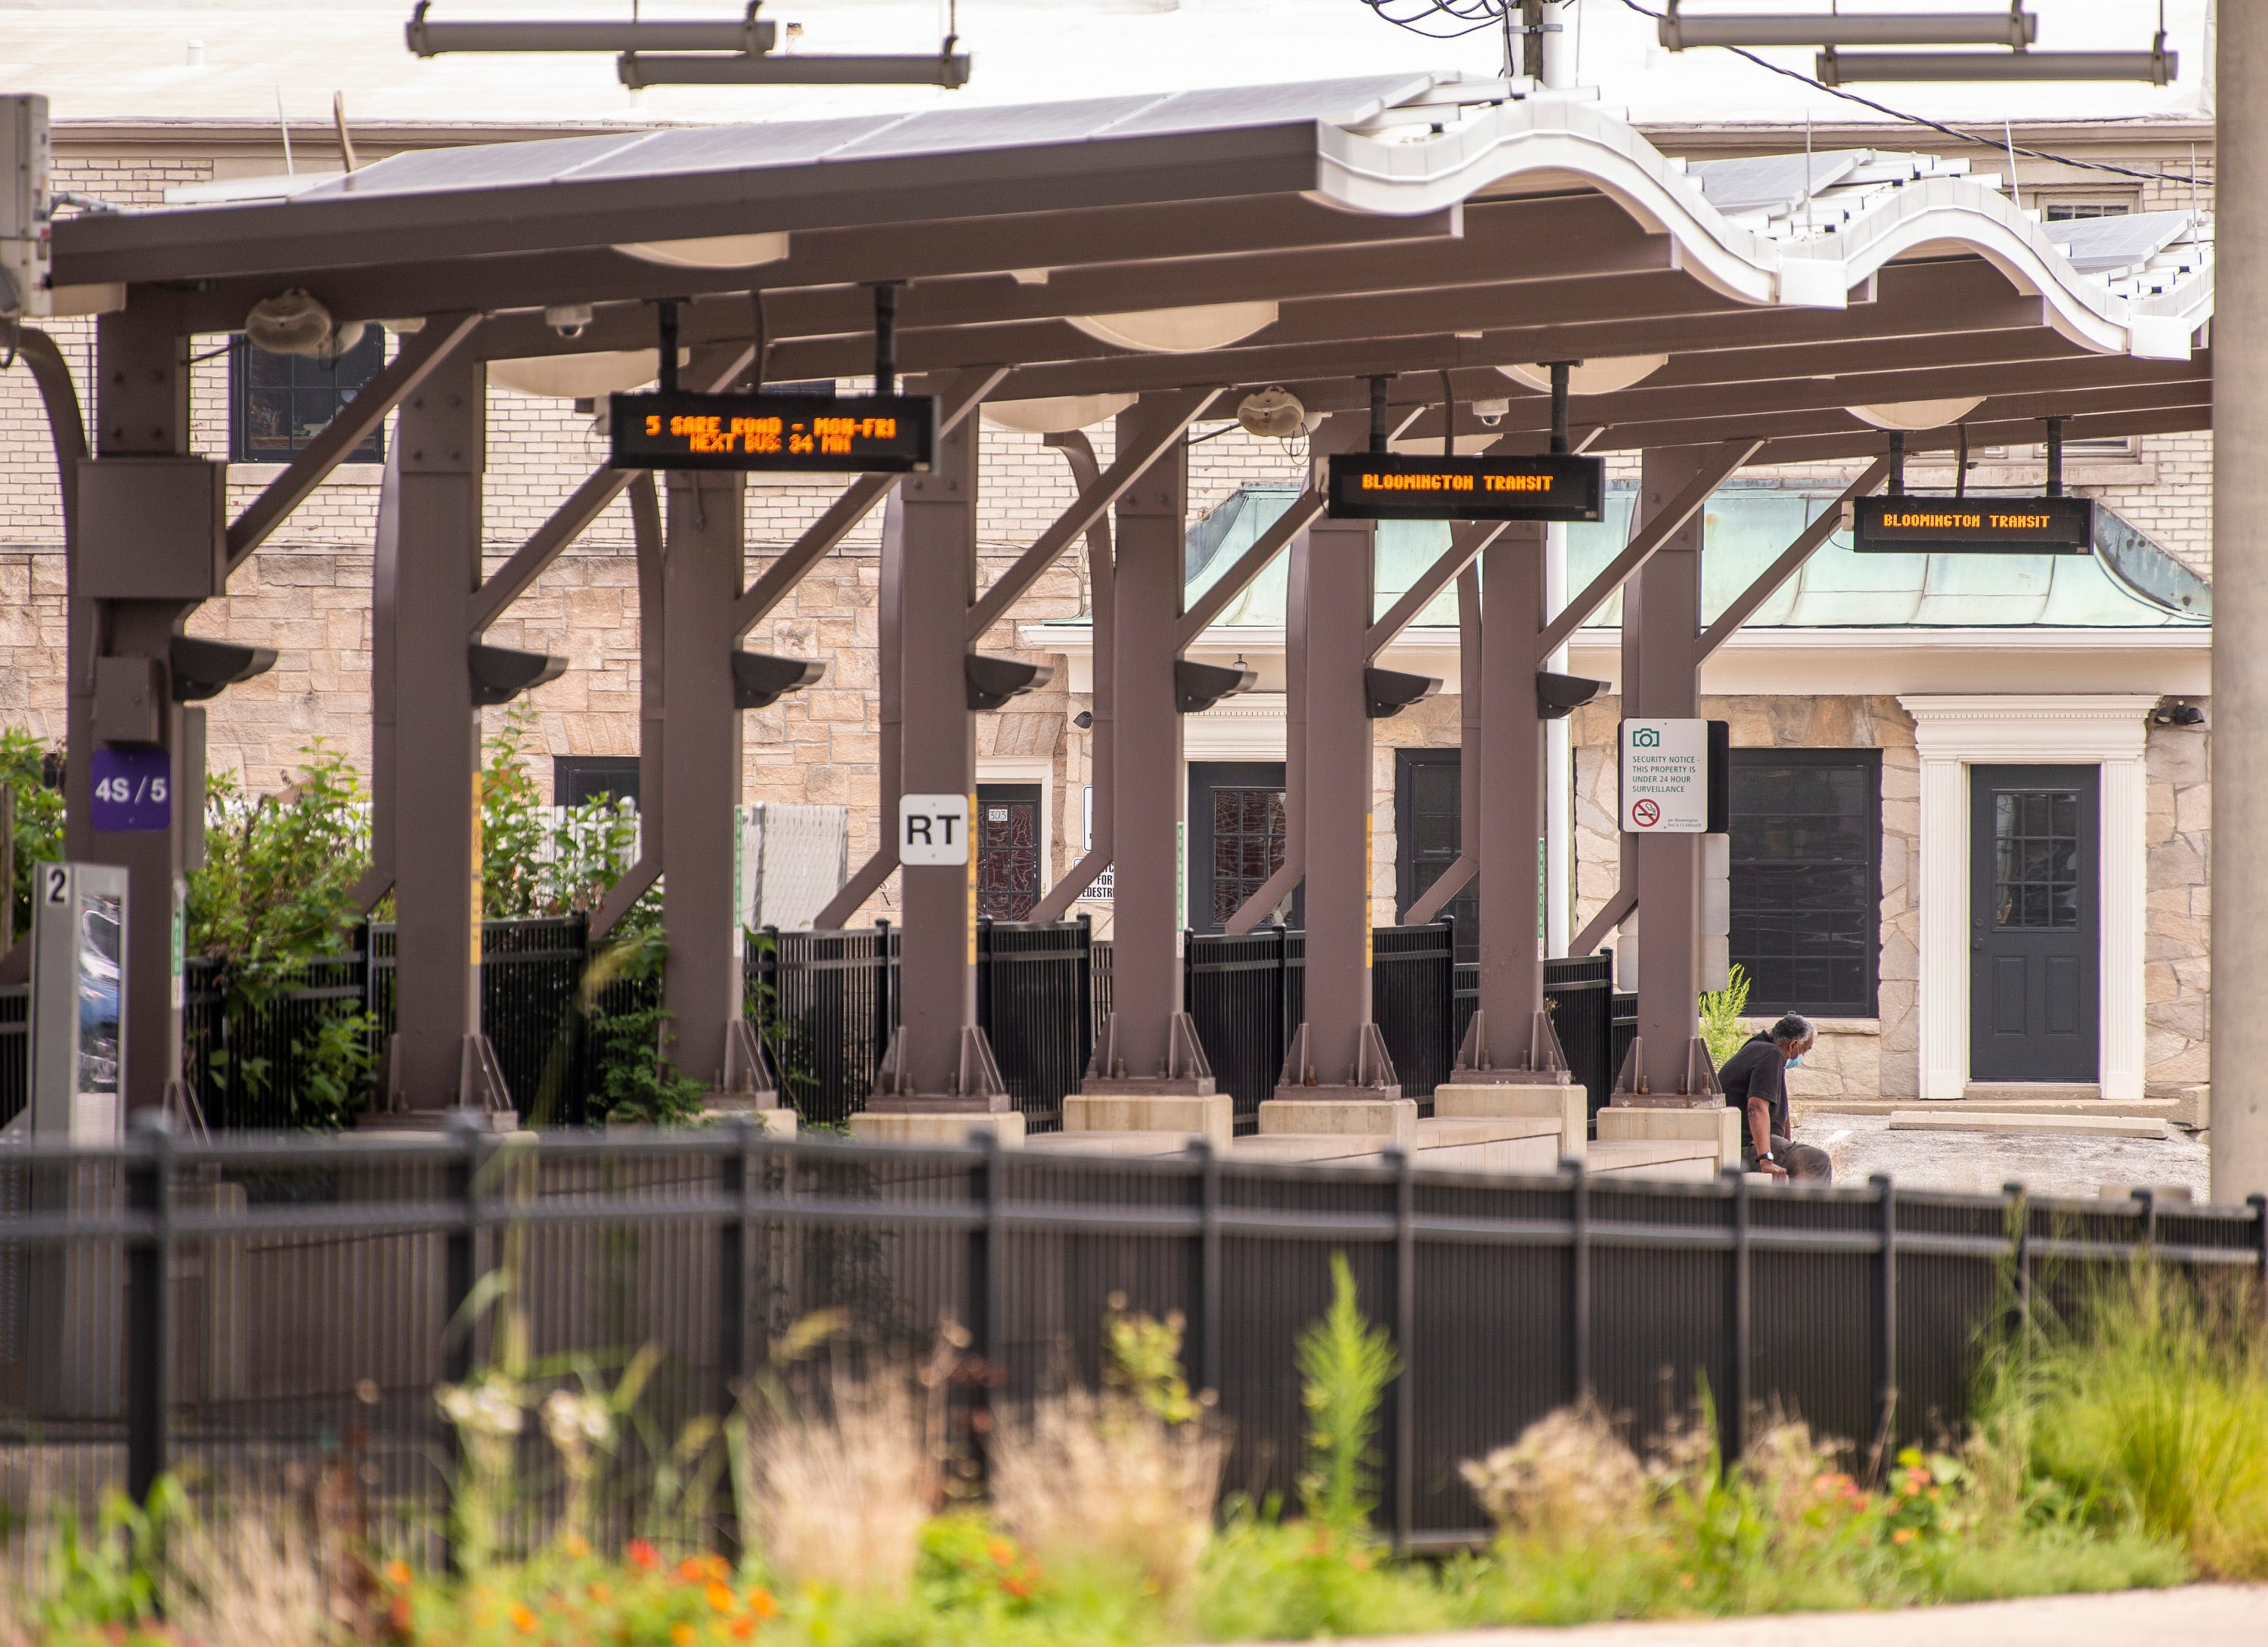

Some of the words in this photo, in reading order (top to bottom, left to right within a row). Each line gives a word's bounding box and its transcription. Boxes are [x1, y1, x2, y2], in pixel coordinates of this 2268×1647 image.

[646, 415, 662, 436] 5
[689, 432, 737, 454] NEXT
[1362, 473, 1473, 491] BLOOMINGTON
[1483, 475, 1554, 491] TRANSIT
[1883, 513, 1981, 528] BLOOMINGTON
[1988, 515, 2050, 528] TRANSIT
[1632, 755, 1667, 763] SECURITY
[94, 778, 130, 803] 4S
[150, 778, 167, 803] 5
[990, 810, 1006, 820] 303
[907, 815, 961, 845] RT
[50, 870, 66, 902] 2
[1097, 875, 1113, 885] FOR
